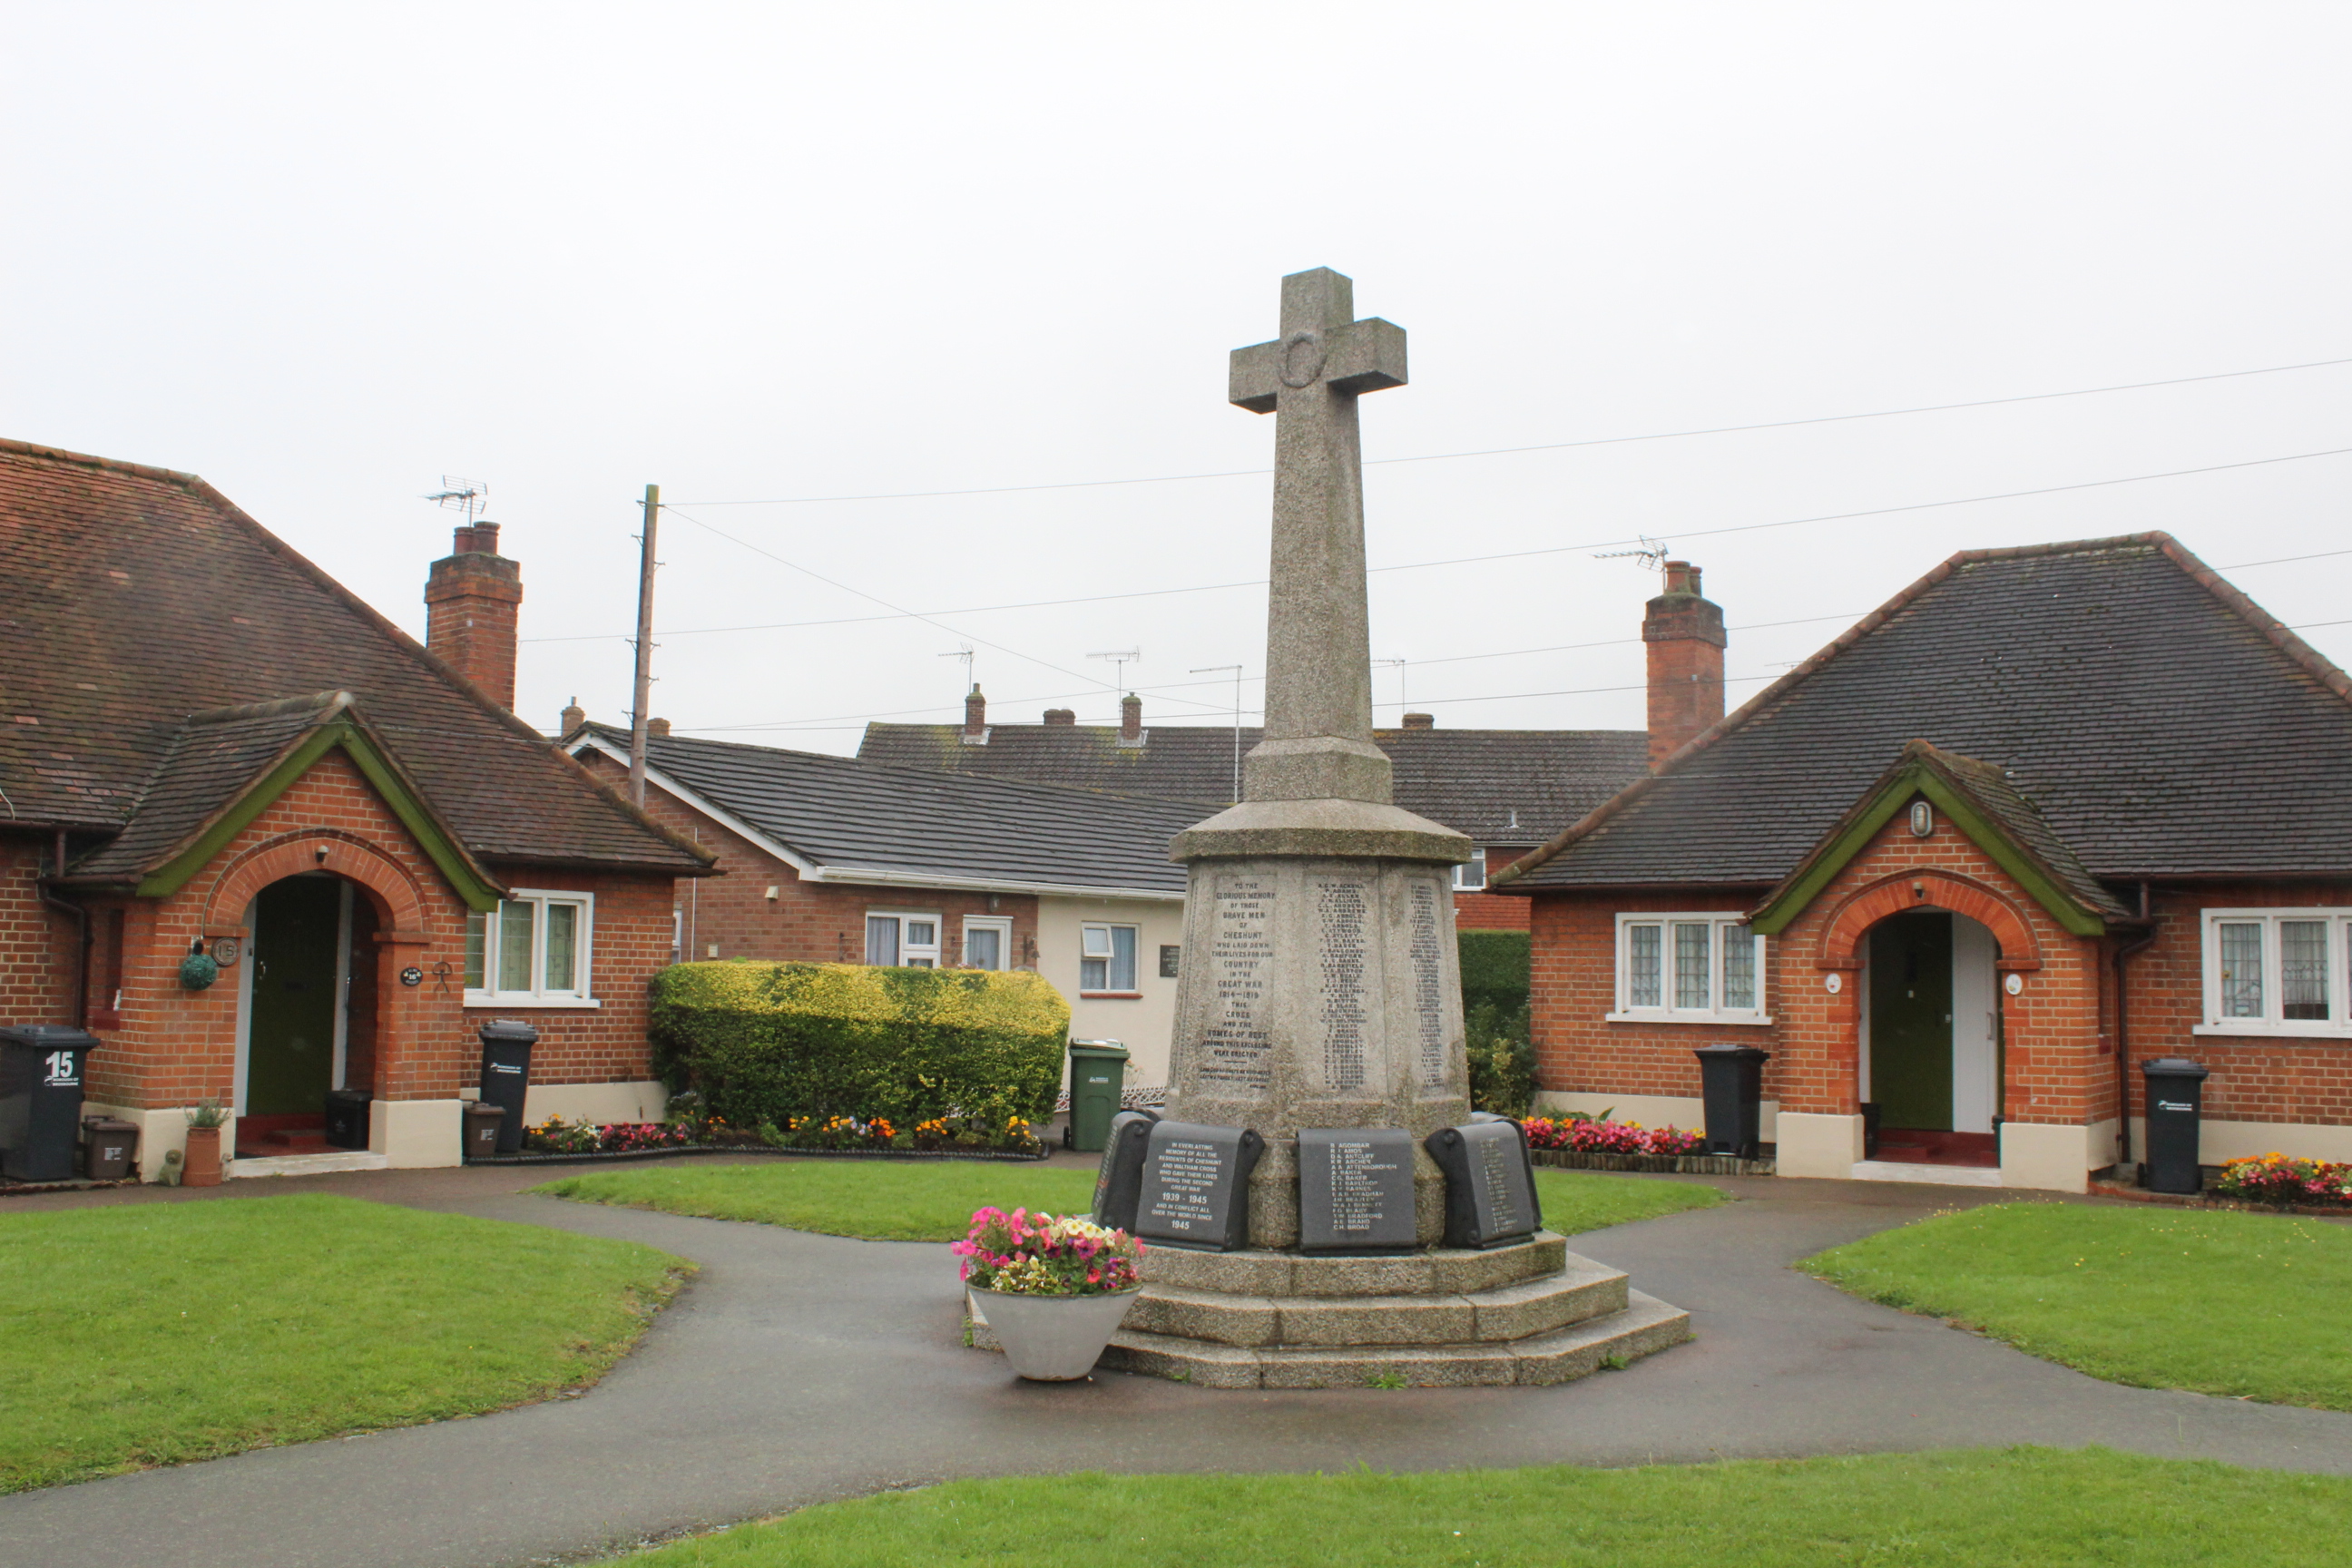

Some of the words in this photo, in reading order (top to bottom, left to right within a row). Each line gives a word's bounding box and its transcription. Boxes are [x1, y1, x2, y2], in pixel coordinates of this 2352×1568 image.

[219, 946, 234, 956] 15
[45, 1051, 73, 1077] 15
[1162, 1192, 1180, 1201] 1939
[1189, 1195, 1207, 1204] 1945
[1171, 1220, 1190, 1230] 1945
